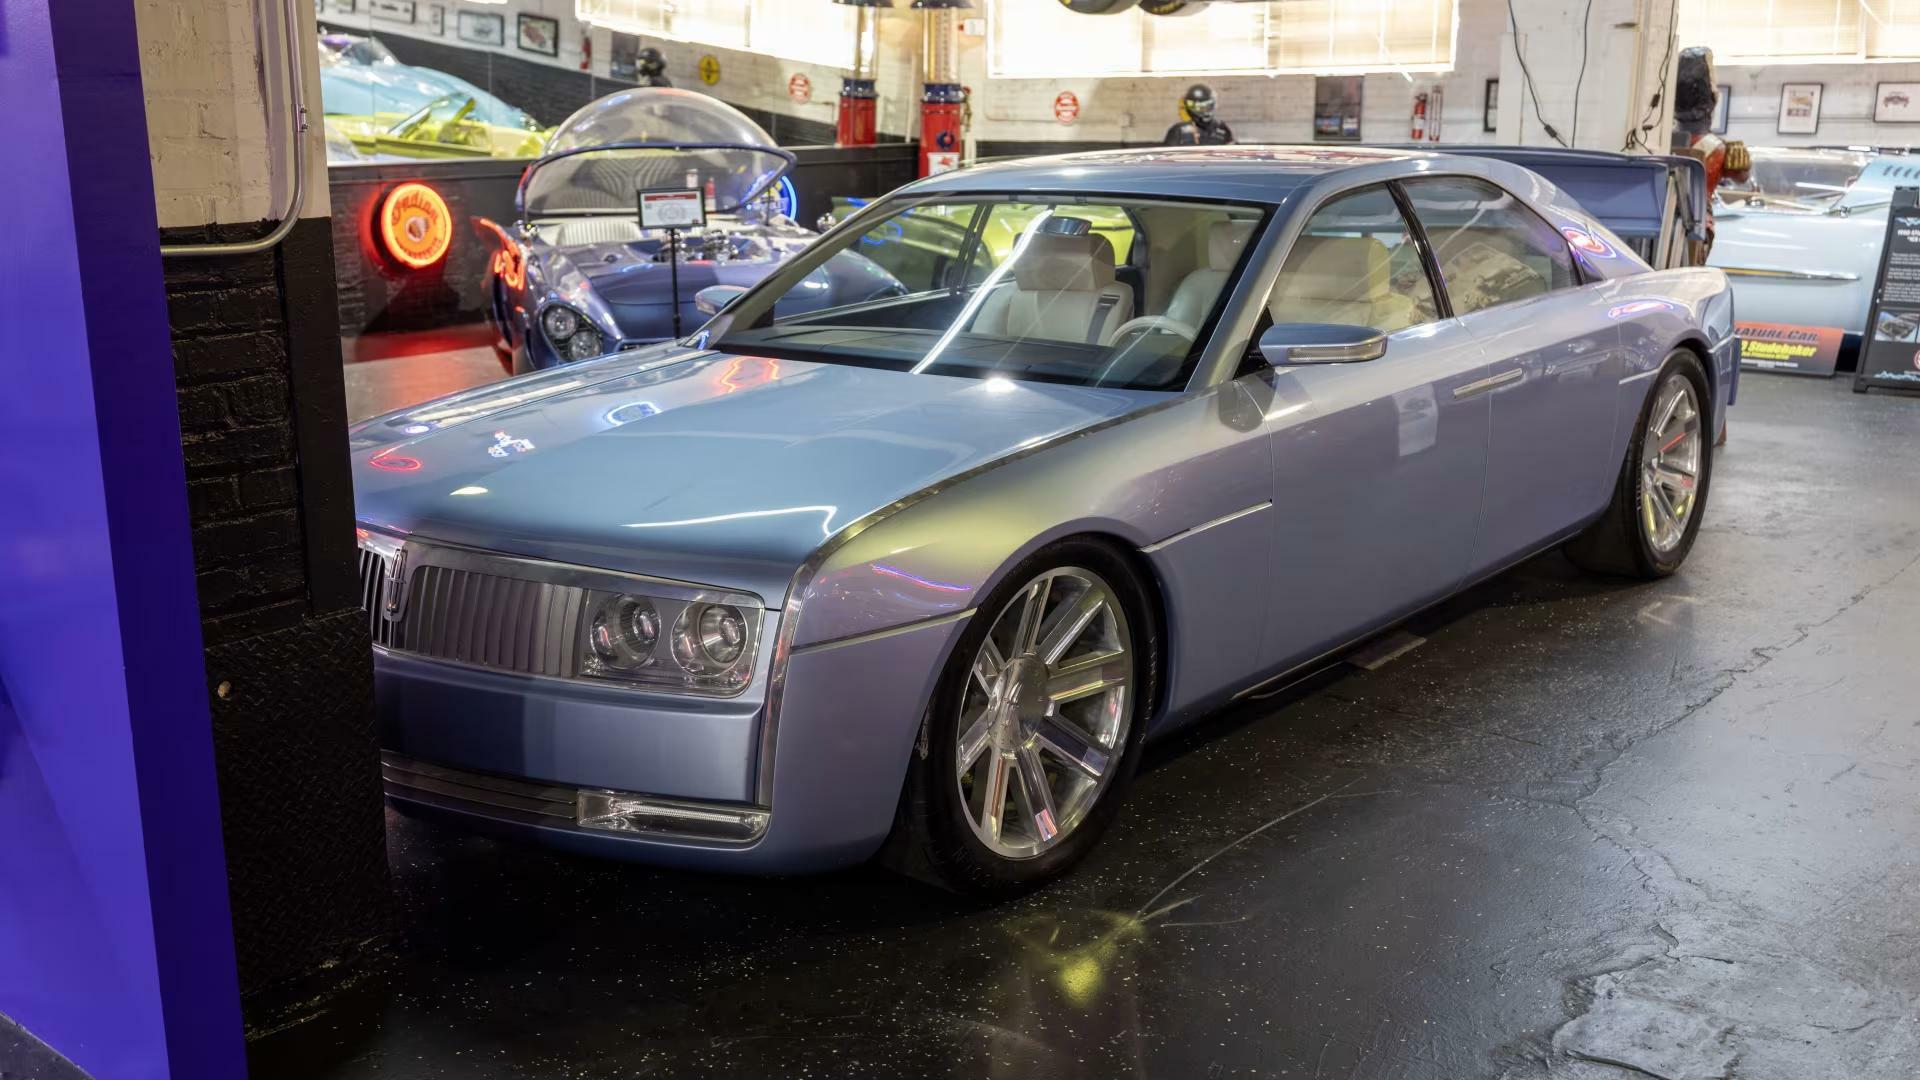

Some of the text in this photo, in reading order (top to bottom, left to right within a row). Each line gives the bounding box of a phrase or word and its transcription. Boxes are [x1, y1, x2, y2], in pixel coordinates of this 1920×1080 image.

[392, 190, 438, 226] Indian
[1734, 327, 1783, 339] EATURE
[1748, 341, 1817, 357] Studebaker
